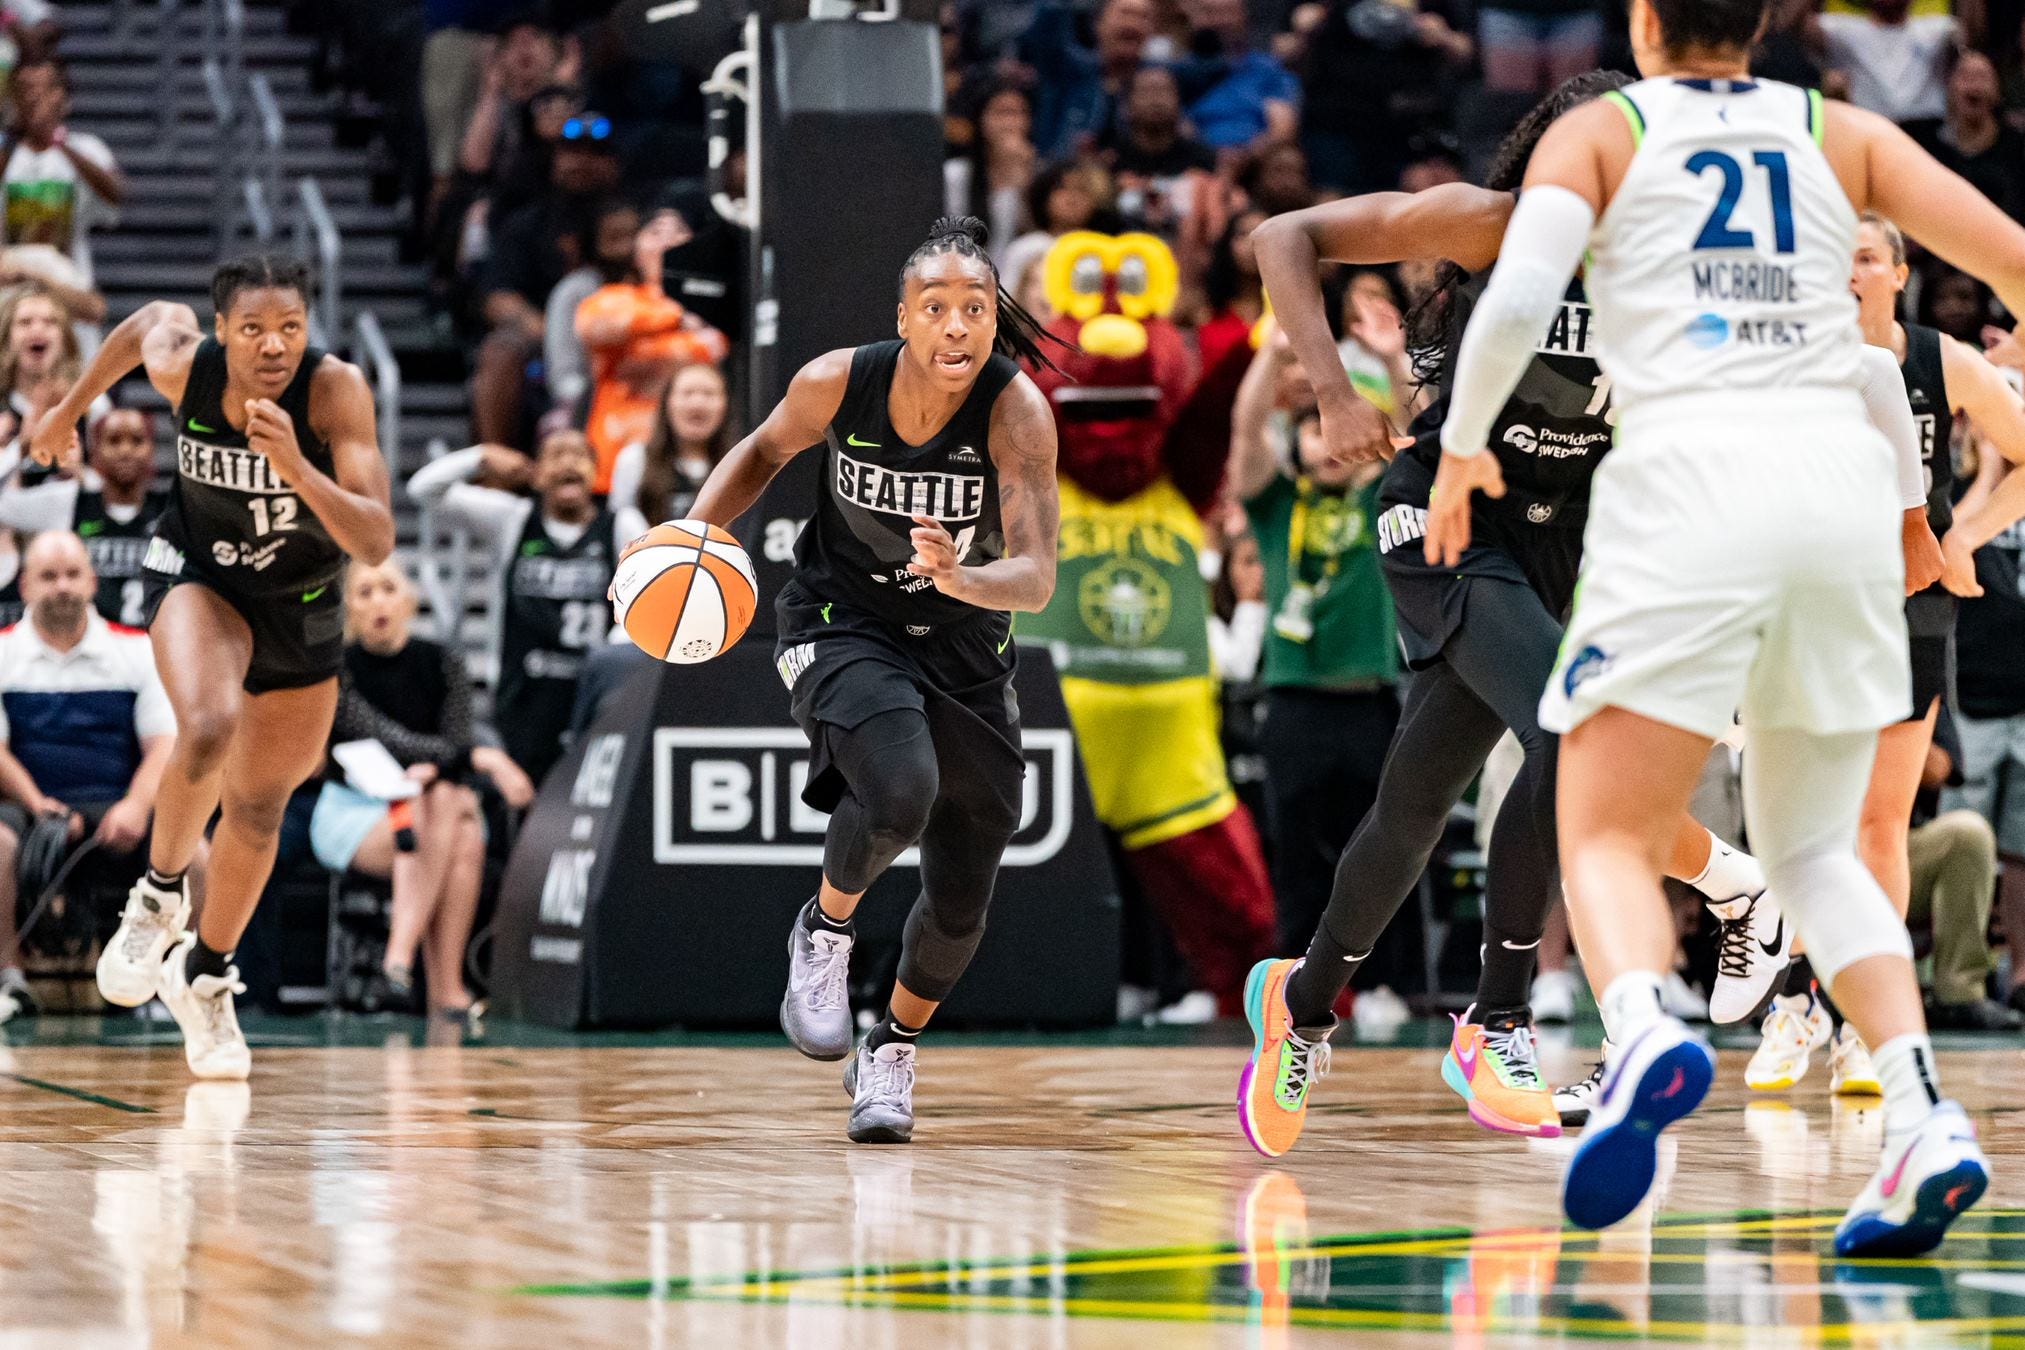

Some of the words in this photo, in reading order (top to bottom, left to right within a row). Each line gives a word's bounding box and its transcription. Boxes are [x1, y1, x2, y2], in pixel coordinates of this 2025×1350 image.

[1684, 150, 1795, 254] 21
[1692, 262, 1799, 303] MCBRIDE
[1736, 319, 1809, 346] AT&T
[1539, 427, 1609, 446] Providence
[179, 439, 293, 490] SEATTL
[948, 453, 982, 463] SYMETRA
[838, 456, 981, 518] SEATTLE
[248, 496, 299, 538] 12
